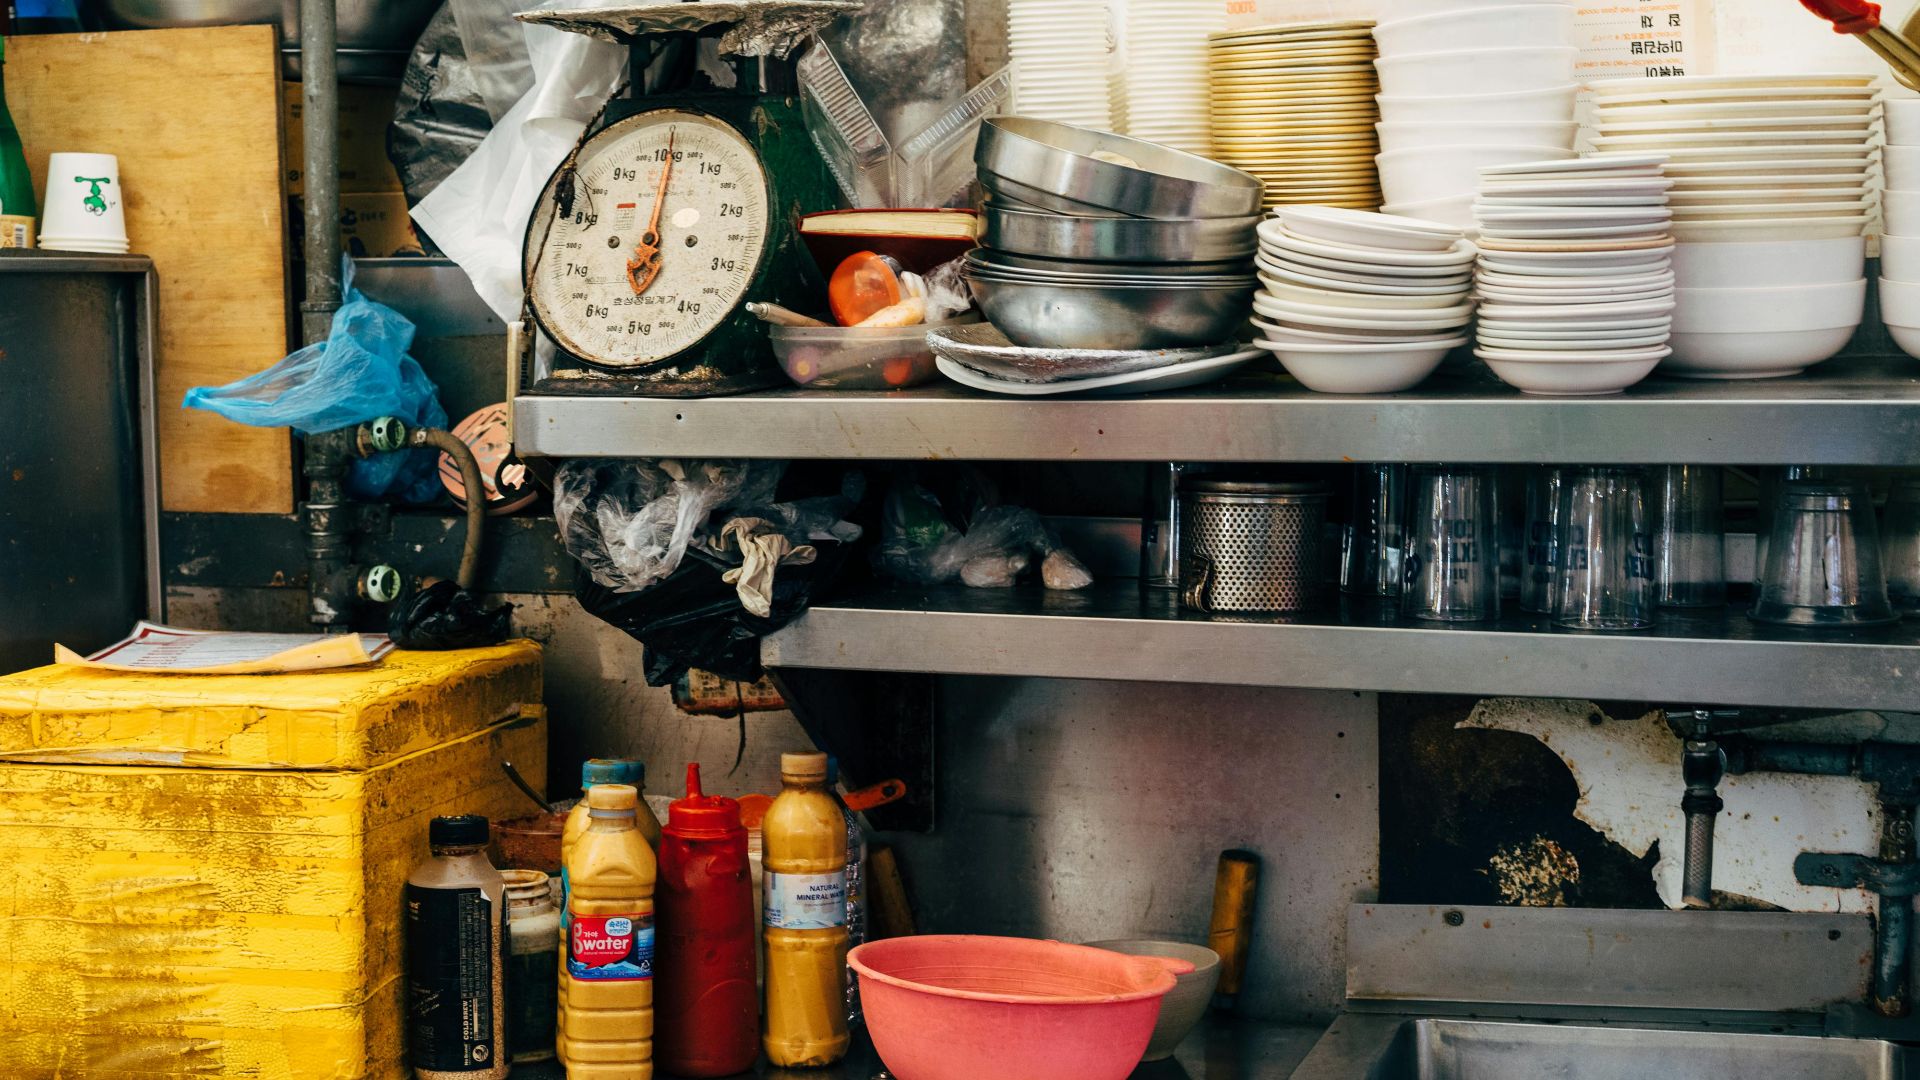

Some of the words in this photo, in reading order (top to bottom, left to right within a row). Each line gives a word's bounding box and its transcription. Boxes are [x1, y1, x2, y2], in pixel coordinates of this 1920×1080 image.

[1630, 40, 1683, 55] 마약김밥
[809, 883, 840, 892] NATURAL
[796, 893, 829, 901] MINERAL
